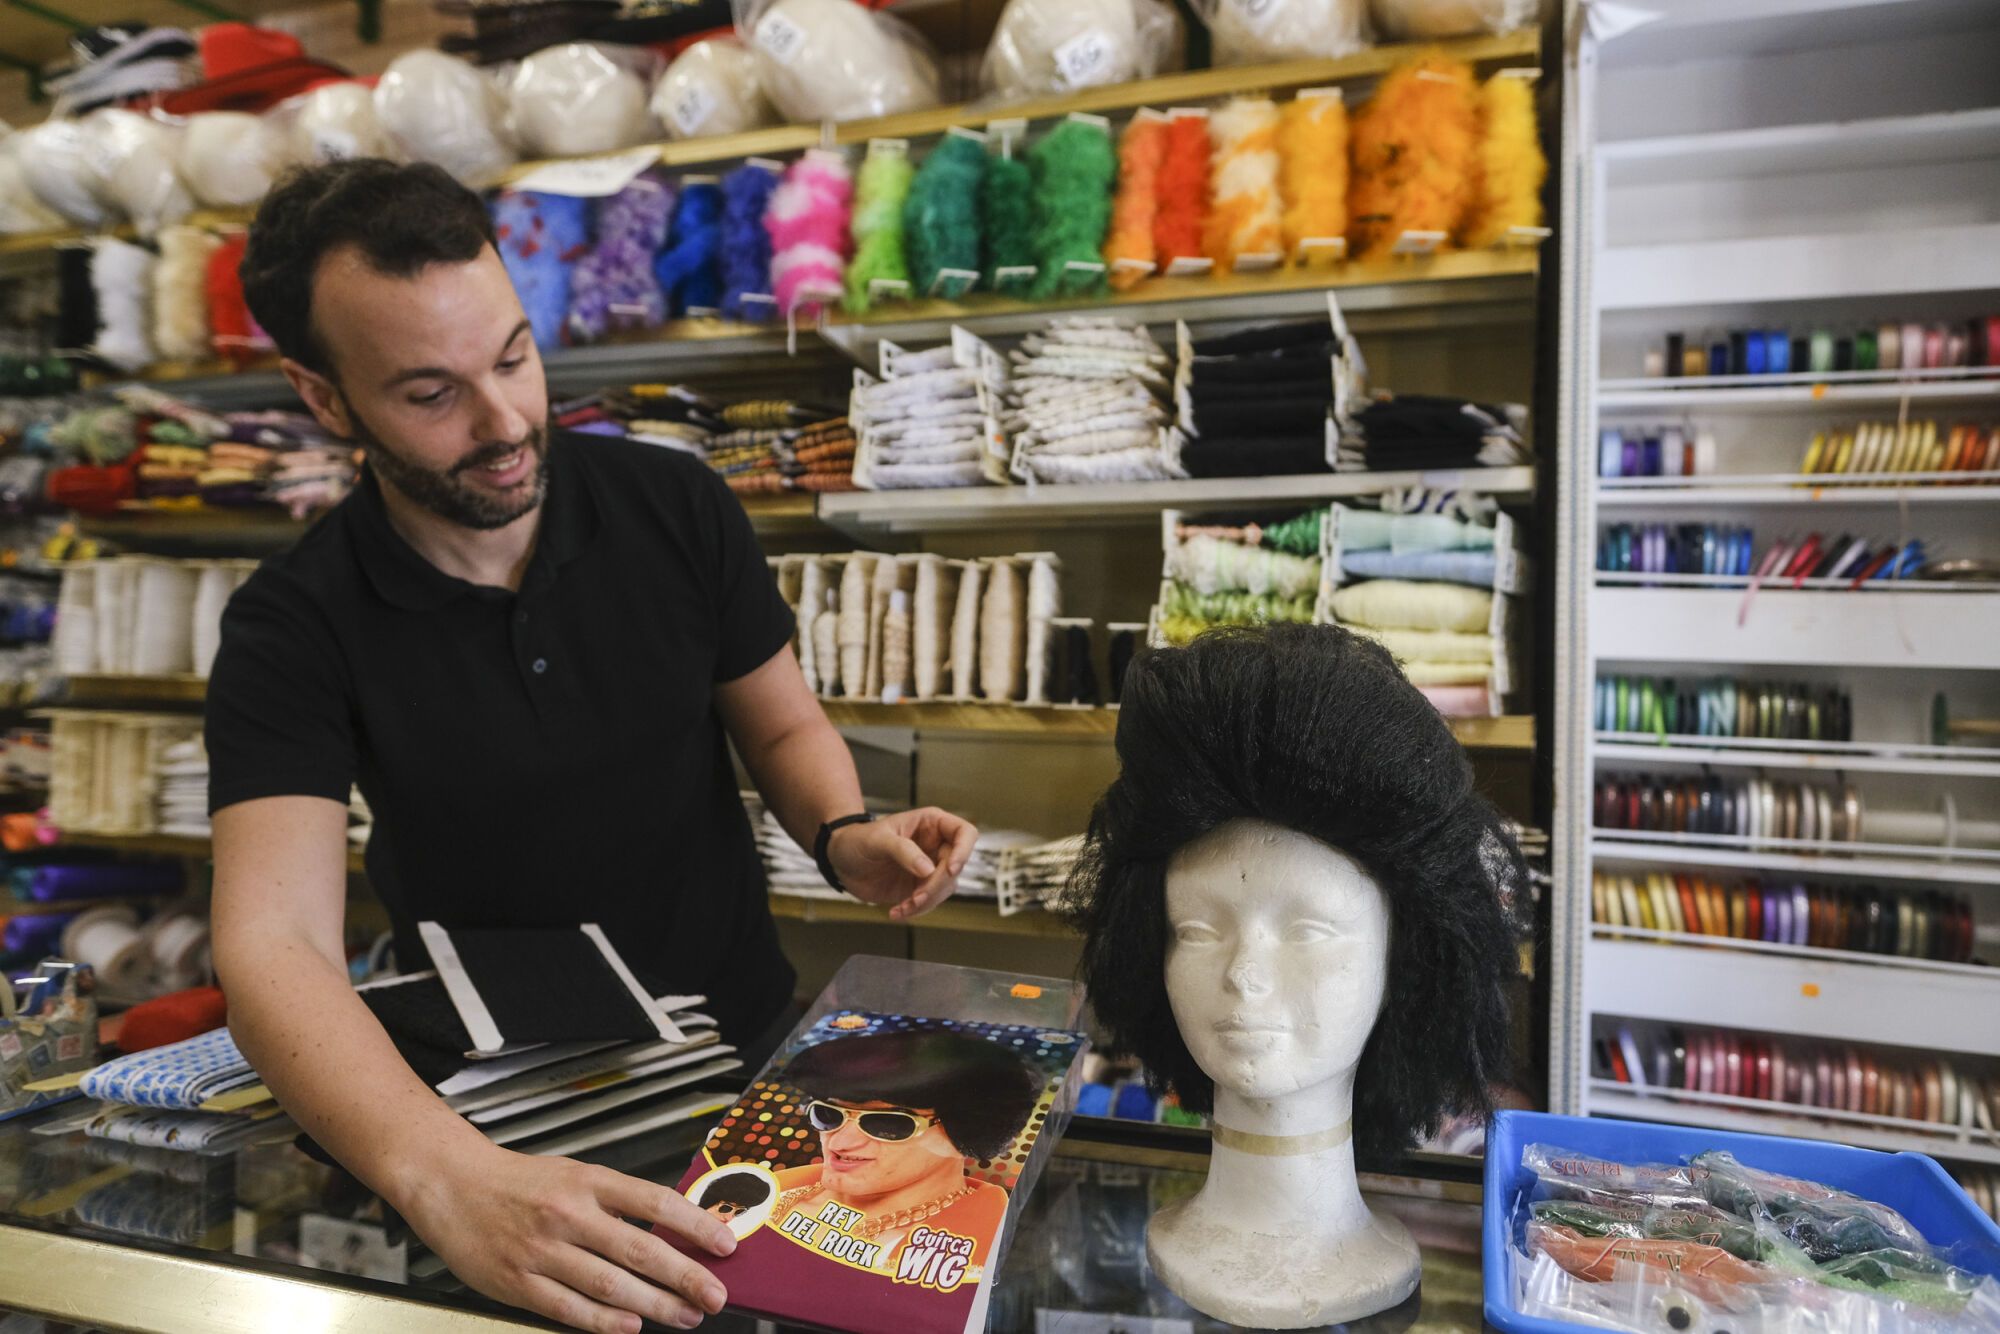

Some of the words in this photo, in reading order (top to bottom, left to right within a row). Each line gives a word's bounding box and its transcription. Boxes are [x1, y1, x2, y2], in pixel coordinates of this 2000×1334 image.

[817, 1201, 863, 1232] REY
[780, 1211, 820, 1245] DEL
[819, 1229, 880, 1268] ROCK
[912, 1227, 973, 1256] Guirca
[897, 1246, 970, 1289] WIG
